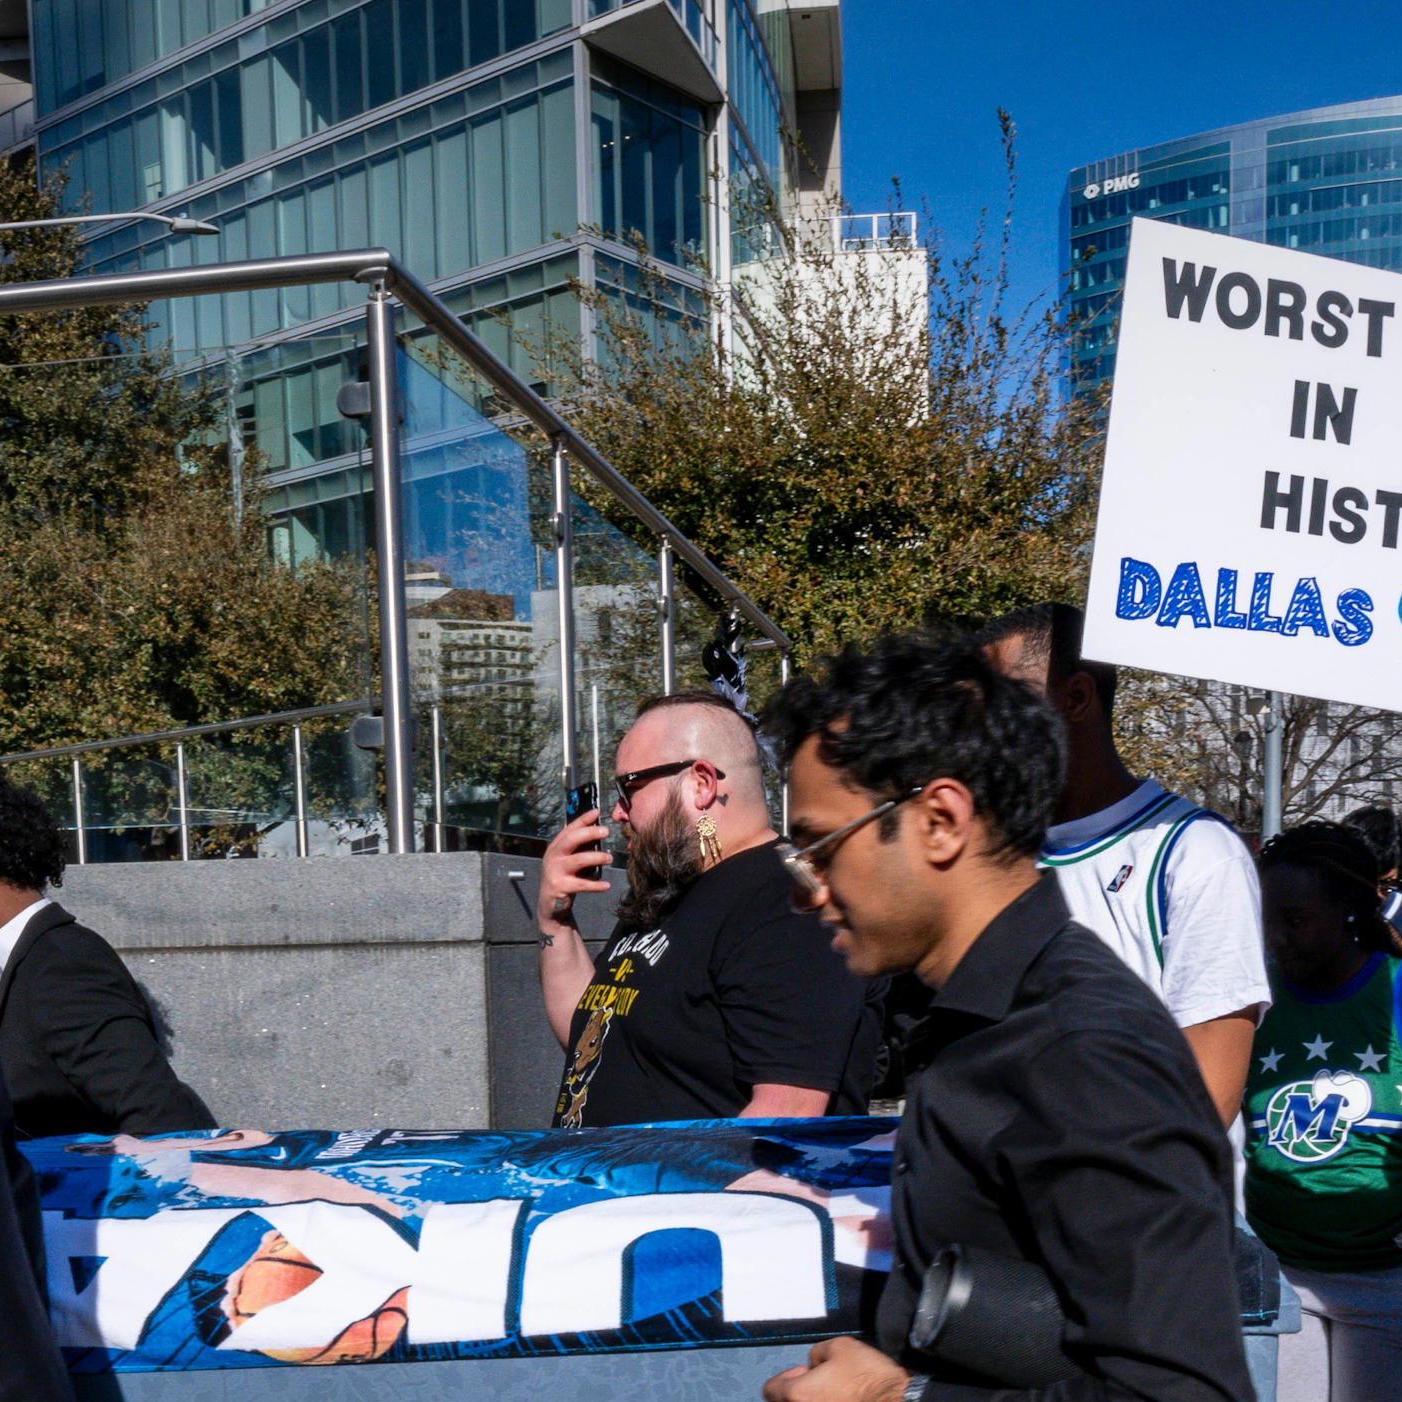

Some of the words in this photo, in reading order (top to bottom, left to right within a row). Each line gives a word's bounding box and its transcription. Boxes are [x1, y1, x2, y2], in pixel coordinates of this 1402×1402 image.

[1103, 172, 1141, 196] PMG
[1161, 256, 1395, 358] WORST
[1289, 379, 1358, 446] IN
[1115, 556, 1374, 648] DALLAS
[41, 1191, 892, 1351] UKA
